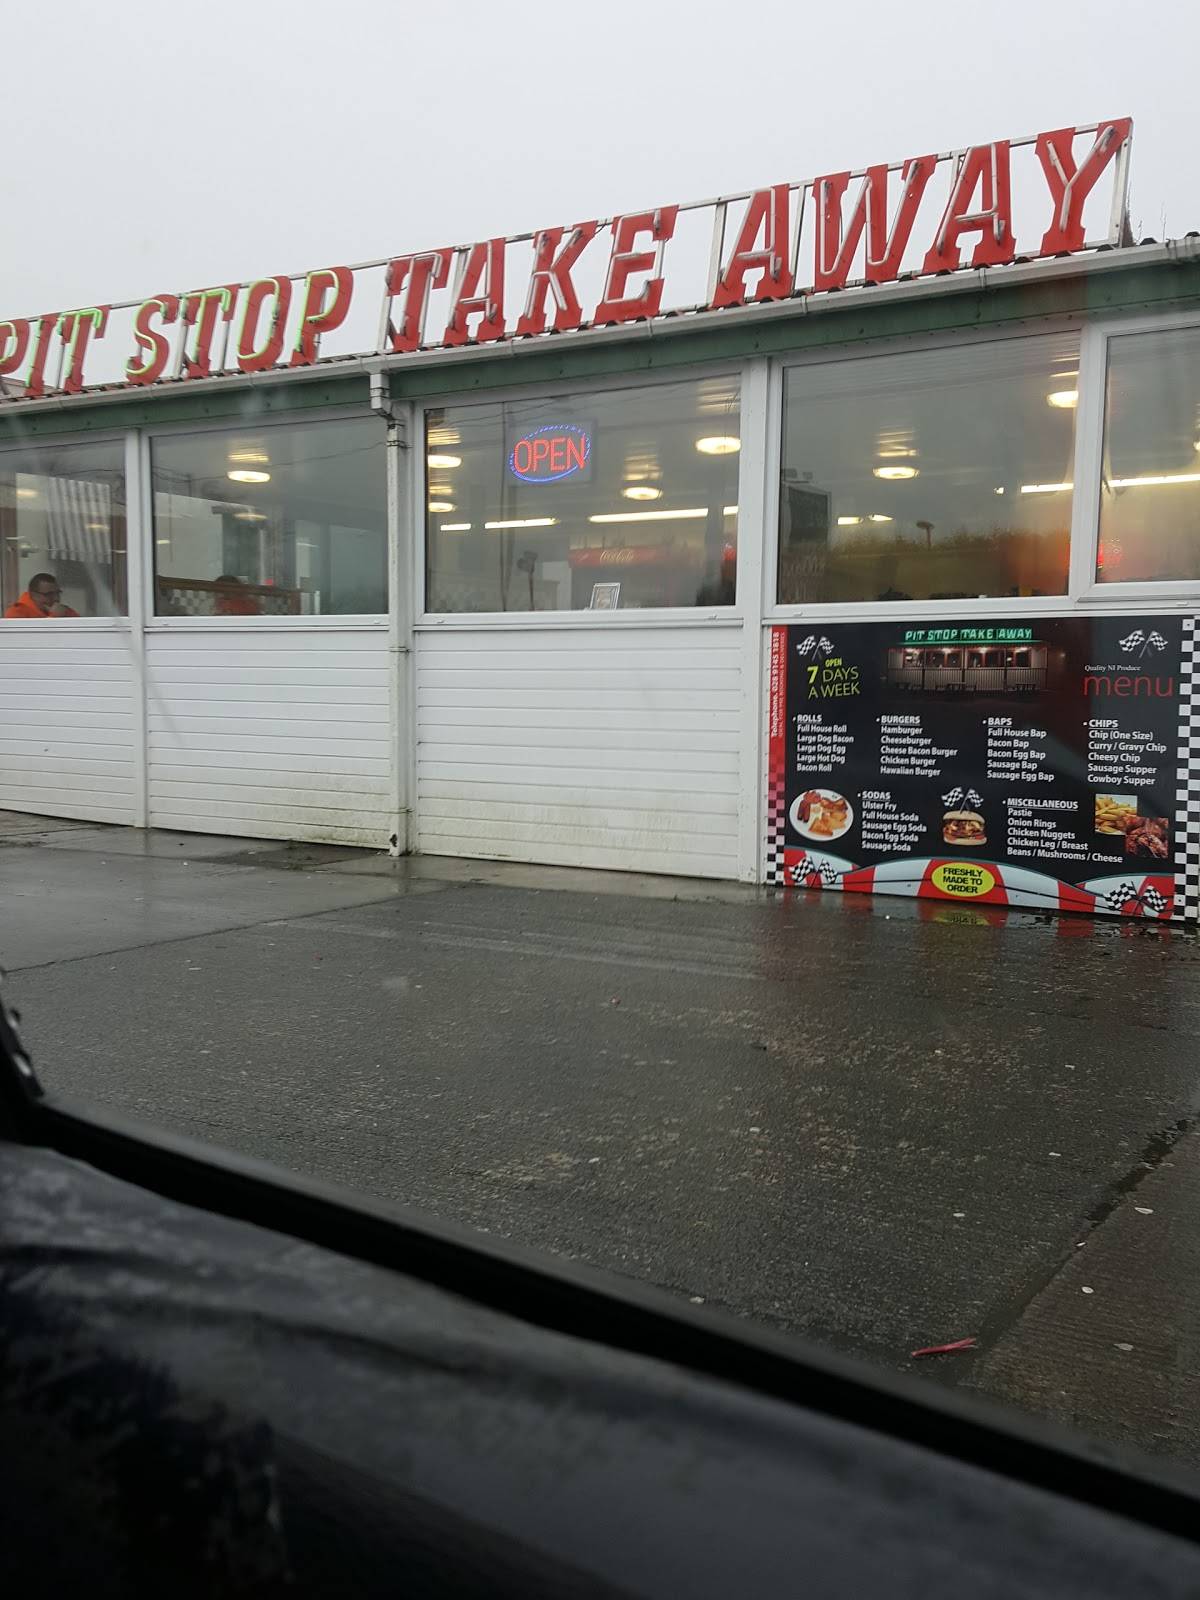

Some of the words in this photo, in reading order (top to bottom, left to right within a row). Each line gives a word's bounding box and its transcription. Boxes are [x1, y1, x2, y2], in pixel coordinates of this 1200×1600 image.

[0, 305, 111, 398] PIT
[125, 266, 353, 389] STOP
[385, 205, 678, 352] TAKE
[713, 117, 1132, 310] AWAY
[514, 433, 585, 472] OPEN
[905, 630, 924, 641] PIT
[927, 630, 957, 640] STOP
[961, 629, 994, 639] TAKE
[998, 628, 1032, 639] AWAY
[825, 658, 842, 667] OPEN
[807, 666, 819, 683] 7
[823, 666, 859, 682] DAYS
[809, 687, 818, 699] A
[822, 681, 860, 697] WEEK
[1082, 675, 1174, 697] menu
[797, 714, 822, 723] ROLLS
[881, 715, 921, 724] BURGERS
[988, 718, 1012, 726] BAPS
[1089, 719, 1119, 728] CHIPS
[797, 724, 810, 732] Full
[833, 725, 847, 733] Roll
[881, 726, 923, 735] Hamburger
[988, 728, 1002, 737] Full
[1004, 729, 1029, 737] House
[1030, 729, 1047, 738] Bap
[797, 734, 816, 743] Large
[818, 735, 831, 743] Dog
[833, 735, 854, 743] Bacon
[881, 736, 932, 745] Cheeseburger
[1089, 731, 1108, 740] Chip
[1110, 732, 1130, 740] (One
[1132, 732, 1153, 741] Size)
[797, 744, 816, 753] Large
[817, 745, 831, 753] Dog
[833, 745, 846, 754] Egg
[988, 739, 1012, 748] Bacon
[1013, 740, 1029, 749] Bap
[1088, 742, 1112, 752] Curry
[1119, 743, 1144, 752] Gravy
[1146, 744, 1167, 753] Chip
[881, 746, 906, 755] Cheese
[908, 747, 930, 755] Bacon
[932, 748, 958, 757] Burger
[988, 750, 1012, 758] Bacon
[1013, 751, 1028, 760] Egg
[1030, 752, 1046, 760] Bap
[797, 753, 816, 763] Large
[817, 754, 829, 762] Hot
[831, 755, 845, 764] Dog
[880, 756, 909, 765] Chicken
[911, 757, 936, 766] Burger
[1088, 753, 1118, 763] Cheesy
[1120, 754, 1141, 763] Chip
[797, 763, 817, 771] Bacon
[819, 764, 832, 772] Roll
[987, 760, 1020, 770] Sausage
[1022, 762, 1037, 770] Bap
[1088, 764, 1125, 774] Sausage
[1126, 766, 1156, 775] Supper
[880, 766, 914, 775] Hawaiian
[915, 767, 941, 777] Burger
[987, 771, 1020, 780] Sausage
[1021, 772, 1036, 781] Egg
[1038, 773, 1054, 782] Bap
[1088, 775, 1122, 785] Cowboy
[1124, 776, 1156, 786] Supper
[862, 791, 891, 801] SODAS
[862, 802, 884, 810] Ulster
[885, 803, 897, 812] Fry
[1008, 798, 1078, 810] MISCELLANEOUS
[862, 812, 875, 820] Full
[877, 812, 899, 820] House
[901, 813, 918, 821] Soda
[1008, 808, 1032, 817] Pastie
[862, 821, 892, 830] Sausage
[893, 822, 907, 832] Egg
[908, 824, 927, 832] Soda
[1008, 817, 1032, 827] Onion
[1034, 818, 1056, 828] Rings
[862, 831, 884, 839] Bacon
[885, 832, 899, 841] Egg
[900, 833, 918, 842] Soda
[1008, 828, 1039, 837] Chicken
[1041, 829, 1075, 839] Nuggets
[862, 840, 892, 850] Sausage
[893, 843, 911, 851] Soda
[1007, 838, 1039, 847] Chicken
[1041, 839, 1055, 849] Leg
[1062, 841, 1088, 850] Breast
[1007, 847, 1031, 856] Beans
[1038, 849, 1085, 860] Mushrooms
[1092, 853, 1123, 863] Cheese
[943, 868, 984, 878] FRESHLY
[943, 877, 969, 885] MADE
[971, 877, 983, 885] TO
[947, 885, 979, 894] ORDER
